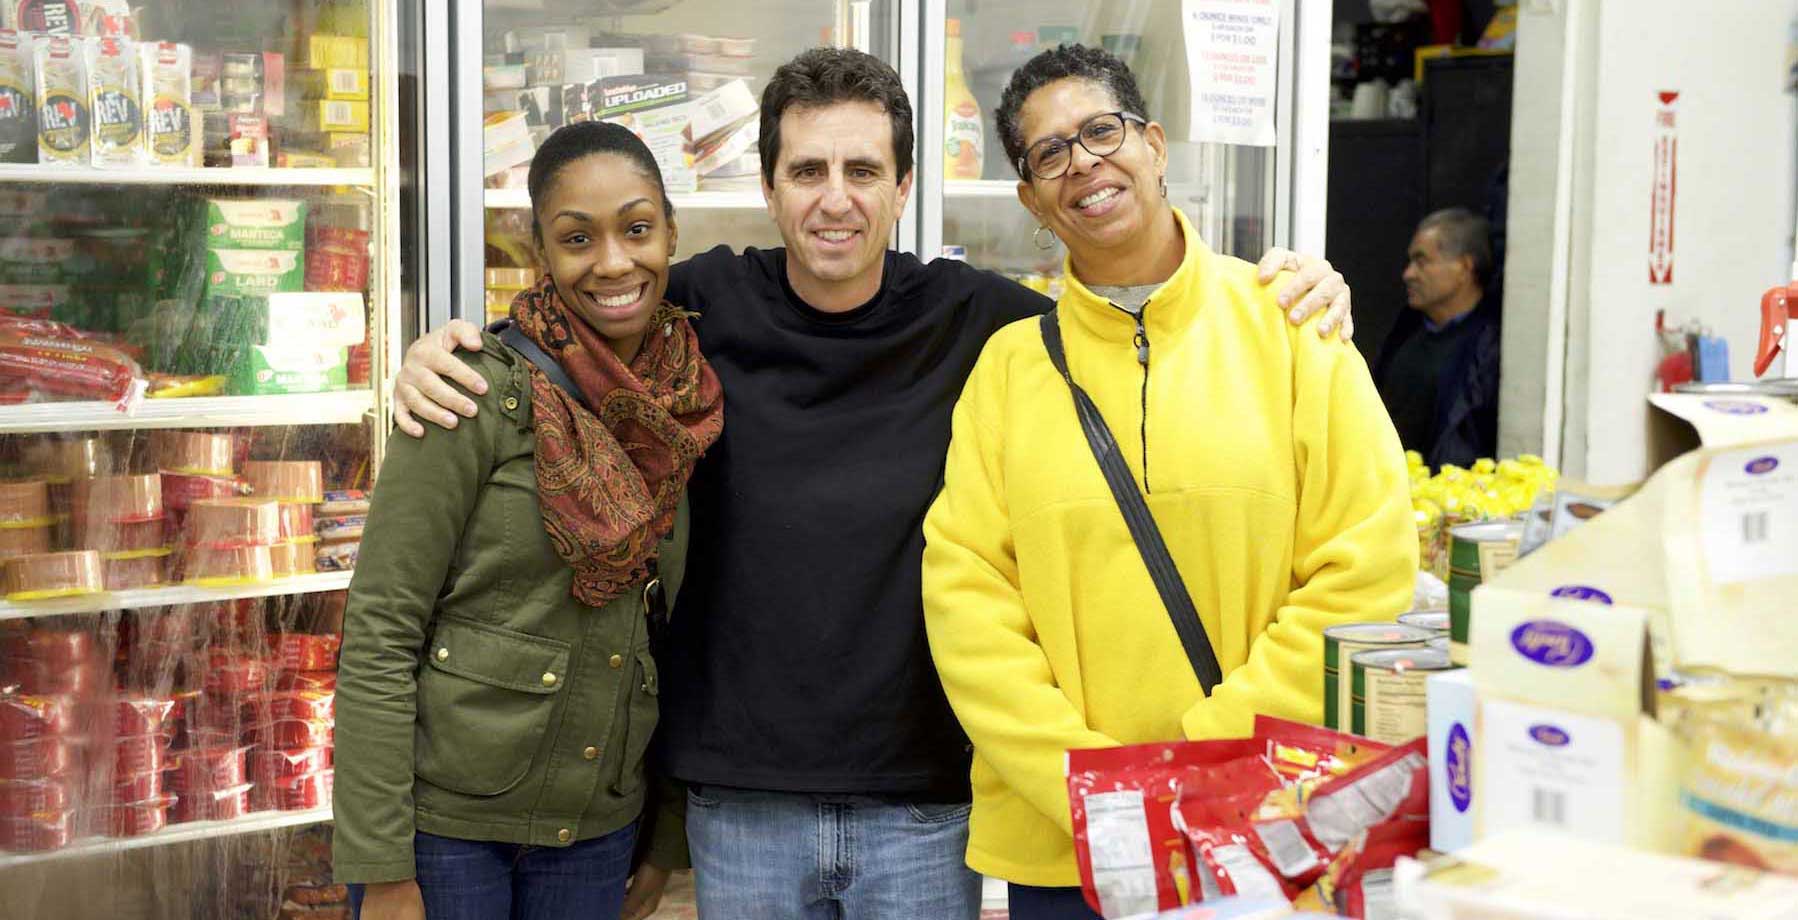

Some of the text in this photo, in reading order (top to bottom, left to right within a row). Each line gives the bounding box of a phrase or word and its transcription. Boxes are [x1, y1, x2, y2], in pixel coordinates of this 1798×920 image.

[96, 90, 128, 124] REV
[605, 81, 687, 107] UPLOADED
[148, 105, 182, 133] REV
[230, 228, 285, 240] MANTECA
[235, 275, 279, 288] LARD
